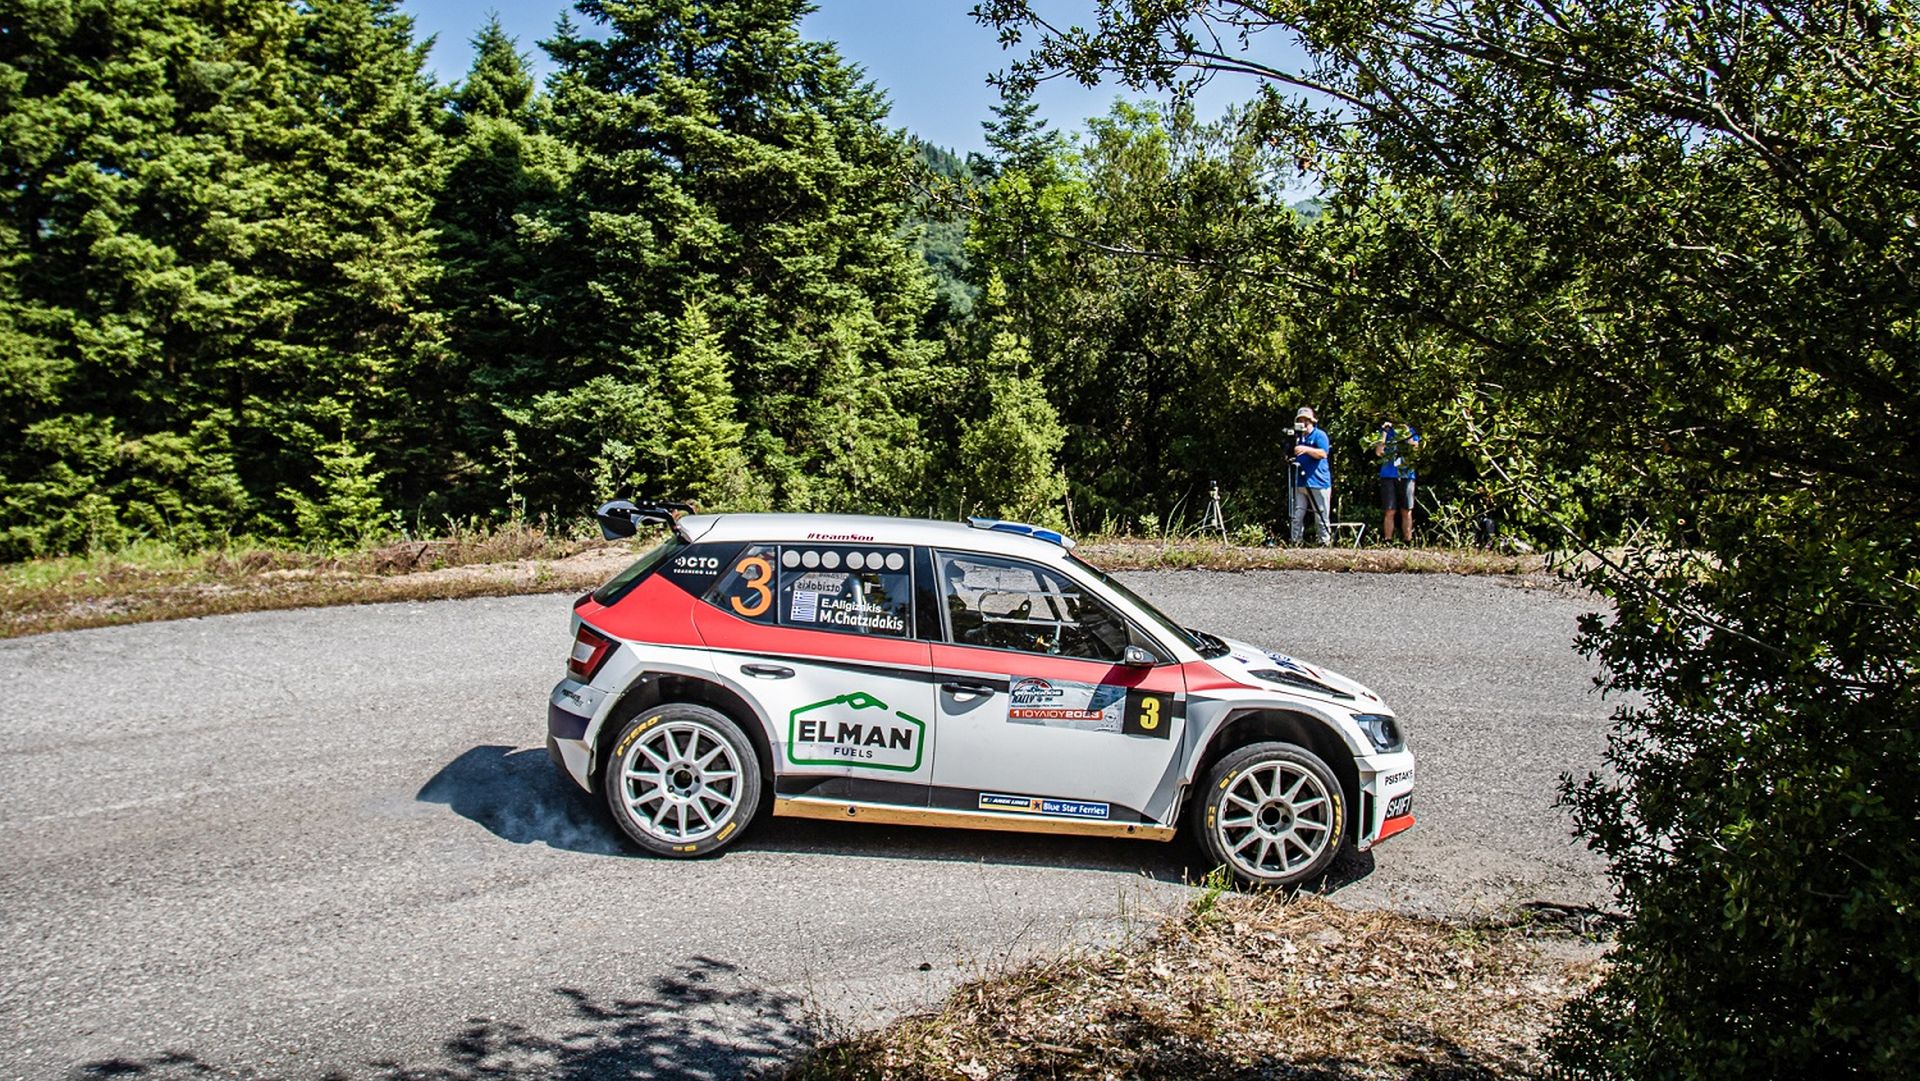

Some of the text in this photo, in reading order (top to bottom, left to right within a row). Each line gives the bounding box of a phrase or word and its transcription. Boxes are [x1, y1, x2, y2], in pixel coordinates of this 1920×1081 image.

[675, 556, 719, 569] OCTO
[730, 556, 773, 617] 3
[819, 609, 904, 630] M.Chatzidakis
[1140, 696, 1160, 730] 3
[798, 720, 913, 750] ELMAN
[833, 747, 873, 759] FUELS
[1042, 802, 1105, 815] Blue Star Ferries
[1386, 794, 1412, 818] SHIFT
